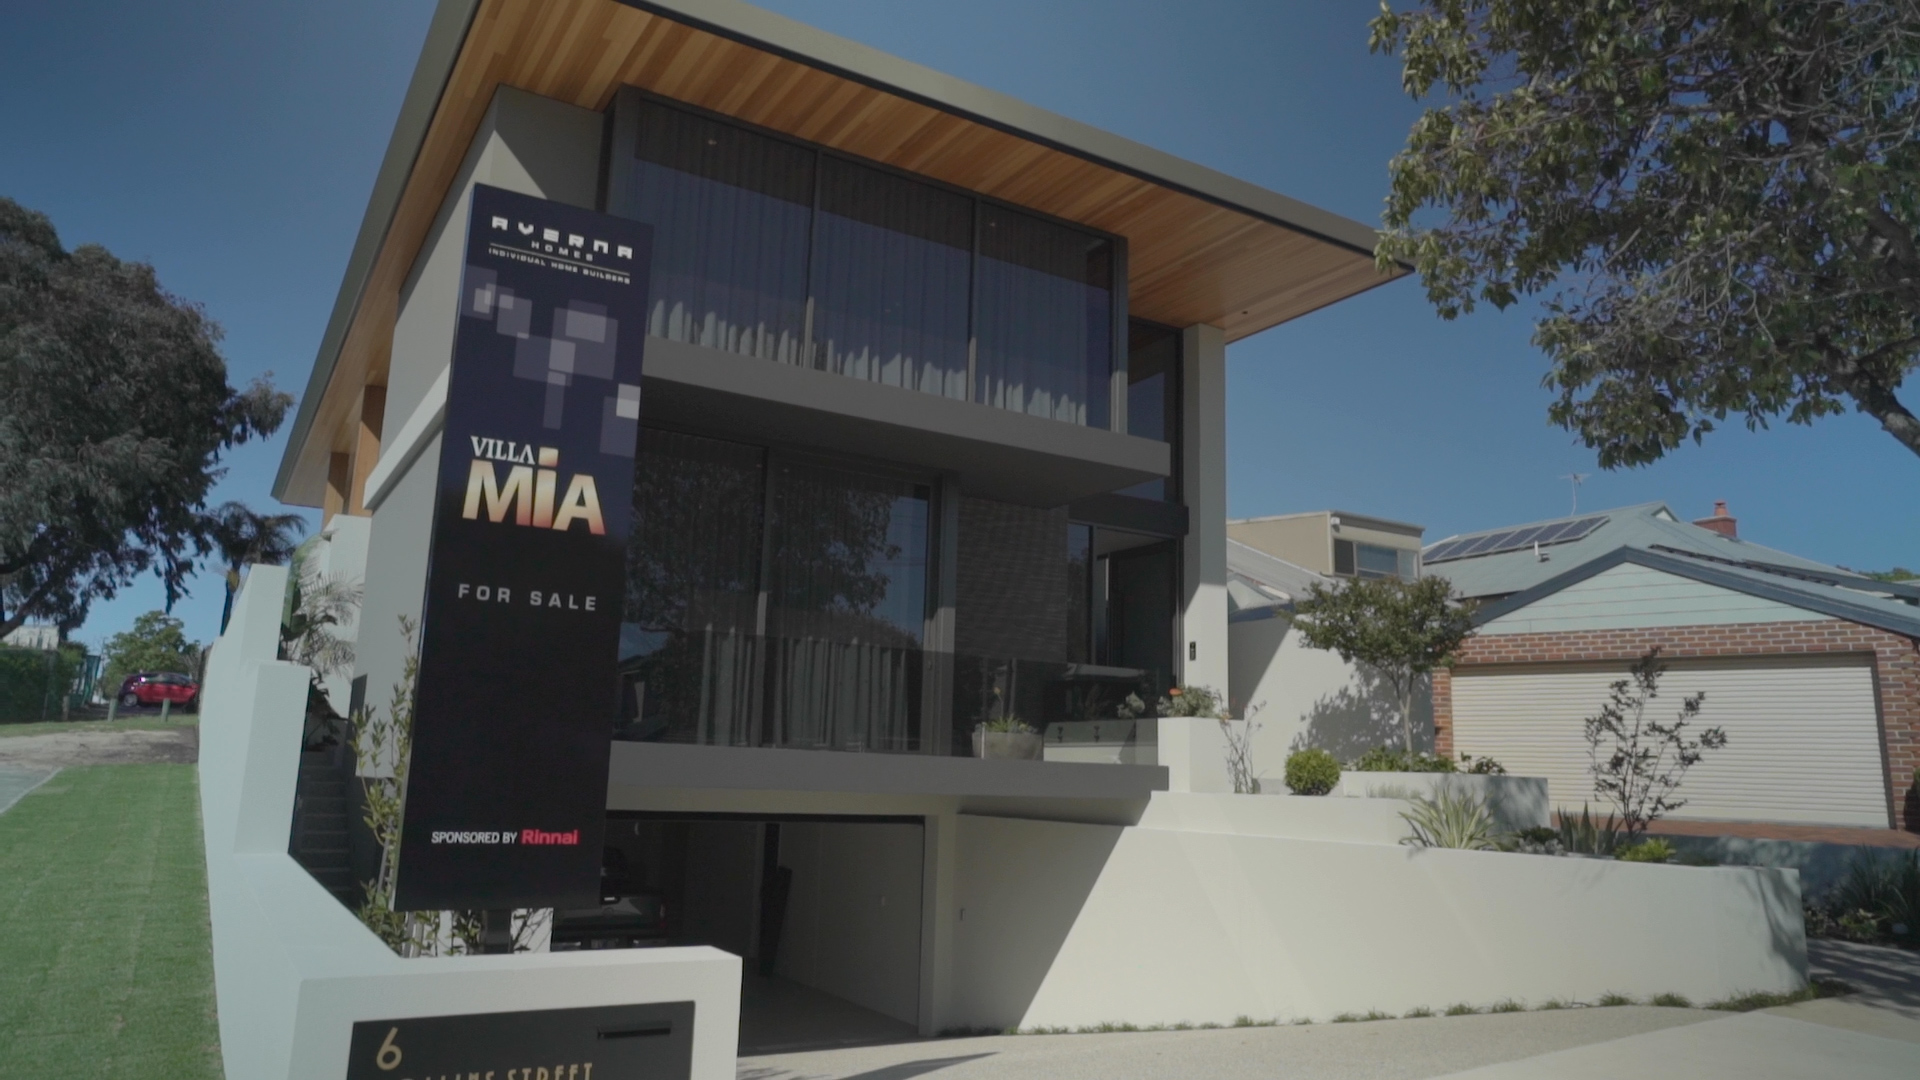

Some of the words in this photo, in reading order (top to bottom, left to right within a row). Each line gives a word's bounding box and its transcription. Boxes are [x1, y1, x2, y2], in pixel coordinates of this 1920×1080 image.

[491, 216, 633, 259] AVERNA
[531, 240, 593, 261] HOMES
[488, 247, 546, 266] INDIVIDUAL
[551, 261, 578, 273] HOME
[583, 268, 631, 284] BUILDERS
[470, 435, 536, 465] VILLA
[458, 583, 511, 603] FOR
[530, 591, 596, 611] SALE
[431, 831, 500, 844] SPONSORED
[502, 831, 518, 844] BY
[521, 829, 579, 845] Rinnai
[376, 1027, 402, 1071] 6
